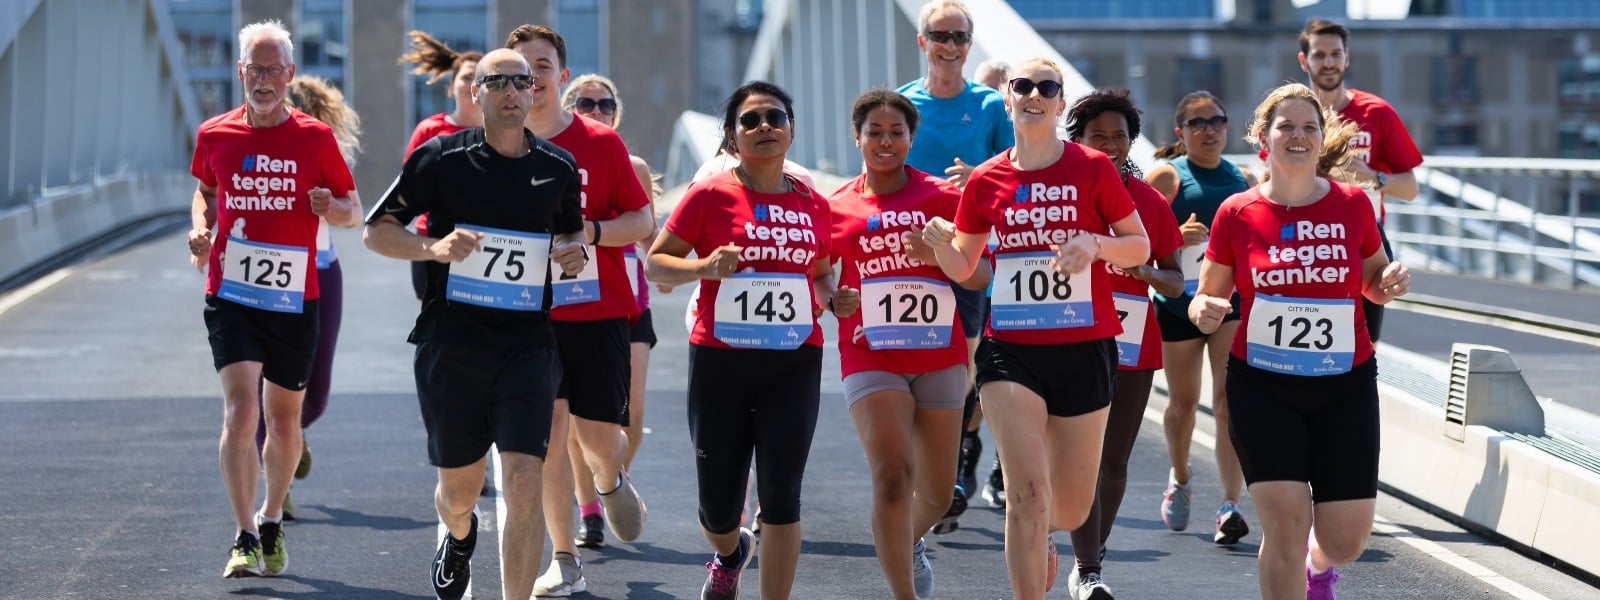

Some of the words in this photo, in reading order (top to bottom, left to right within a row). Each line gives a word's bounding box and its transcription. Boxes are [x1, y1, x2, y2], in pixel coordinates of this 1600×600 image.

[242, 154, 297, 174] #Ren
[232, 173, 296, 194] tegen
[1015, 182, 1077, 204] #Ren
[225, 191, 296, 211] kanker
[753, 203, 813, 227] #Ren
[867, 210, 927, 233] #Ren
[1004, 204, 1077, 227] tegen
[744, 222, 816, 246] tegen
[858, 230, 913, 254] teg
[1280, 220, 1346, 242] #Ren
[482, 246, 526, 281] 75
[854, 252, 926, 280] kanke
[1268, 244, 1348, 266] tegen
[240, 256, 292, 288] 125
[1251, 264, 1350, 288] kanker
[1009, 270, 1072, 302] 108
[734, 290, 796, 323] 143
[878, 293, 939, 324] 120
[1287, 305, 1303, 313] CITY
[1268, 315, 1334, 350] 123
